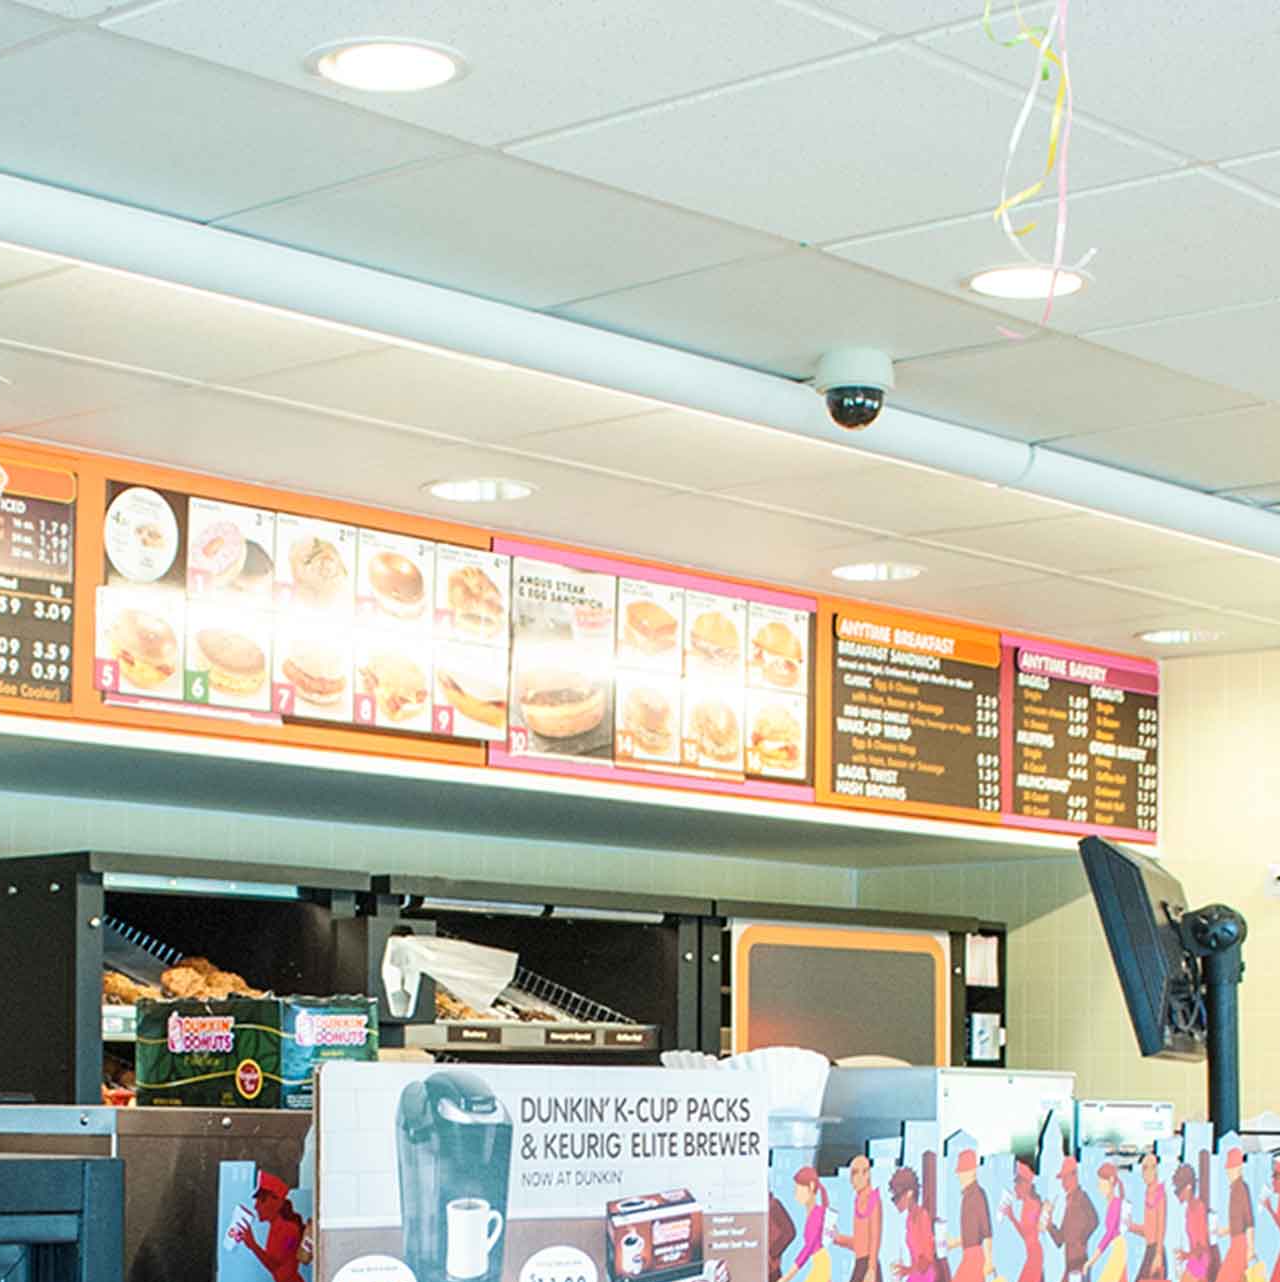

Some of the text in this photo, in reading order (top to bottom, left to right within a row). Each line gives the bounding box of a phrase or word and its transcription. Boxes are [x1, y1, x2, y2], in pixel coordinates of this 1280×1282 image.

[34, 601, 71, 623] 3.09
[33, 642, 70, 663] 3.59
[32, 662, 70, 683] 0.99
[101, 665, 115, 686] 5
[191, 678, 204, 699] 6
[279, 691, 290, 712] 7
[360, 699, 372, 721] 8
[438, 709, 451, 731] 9
[183, 1033, 233, 1051] DONUTS
[314, 1030, 367, 1046] DONUTS
[521, 1096, 751, 1124] DUNKIN' K-CUP PACKS
[521, 1131, 761, 1160] & KEURIG ELITE BREWER
[522, 1172, 554, 1187] NOW
[556, 1171, 572, 1186] AT
